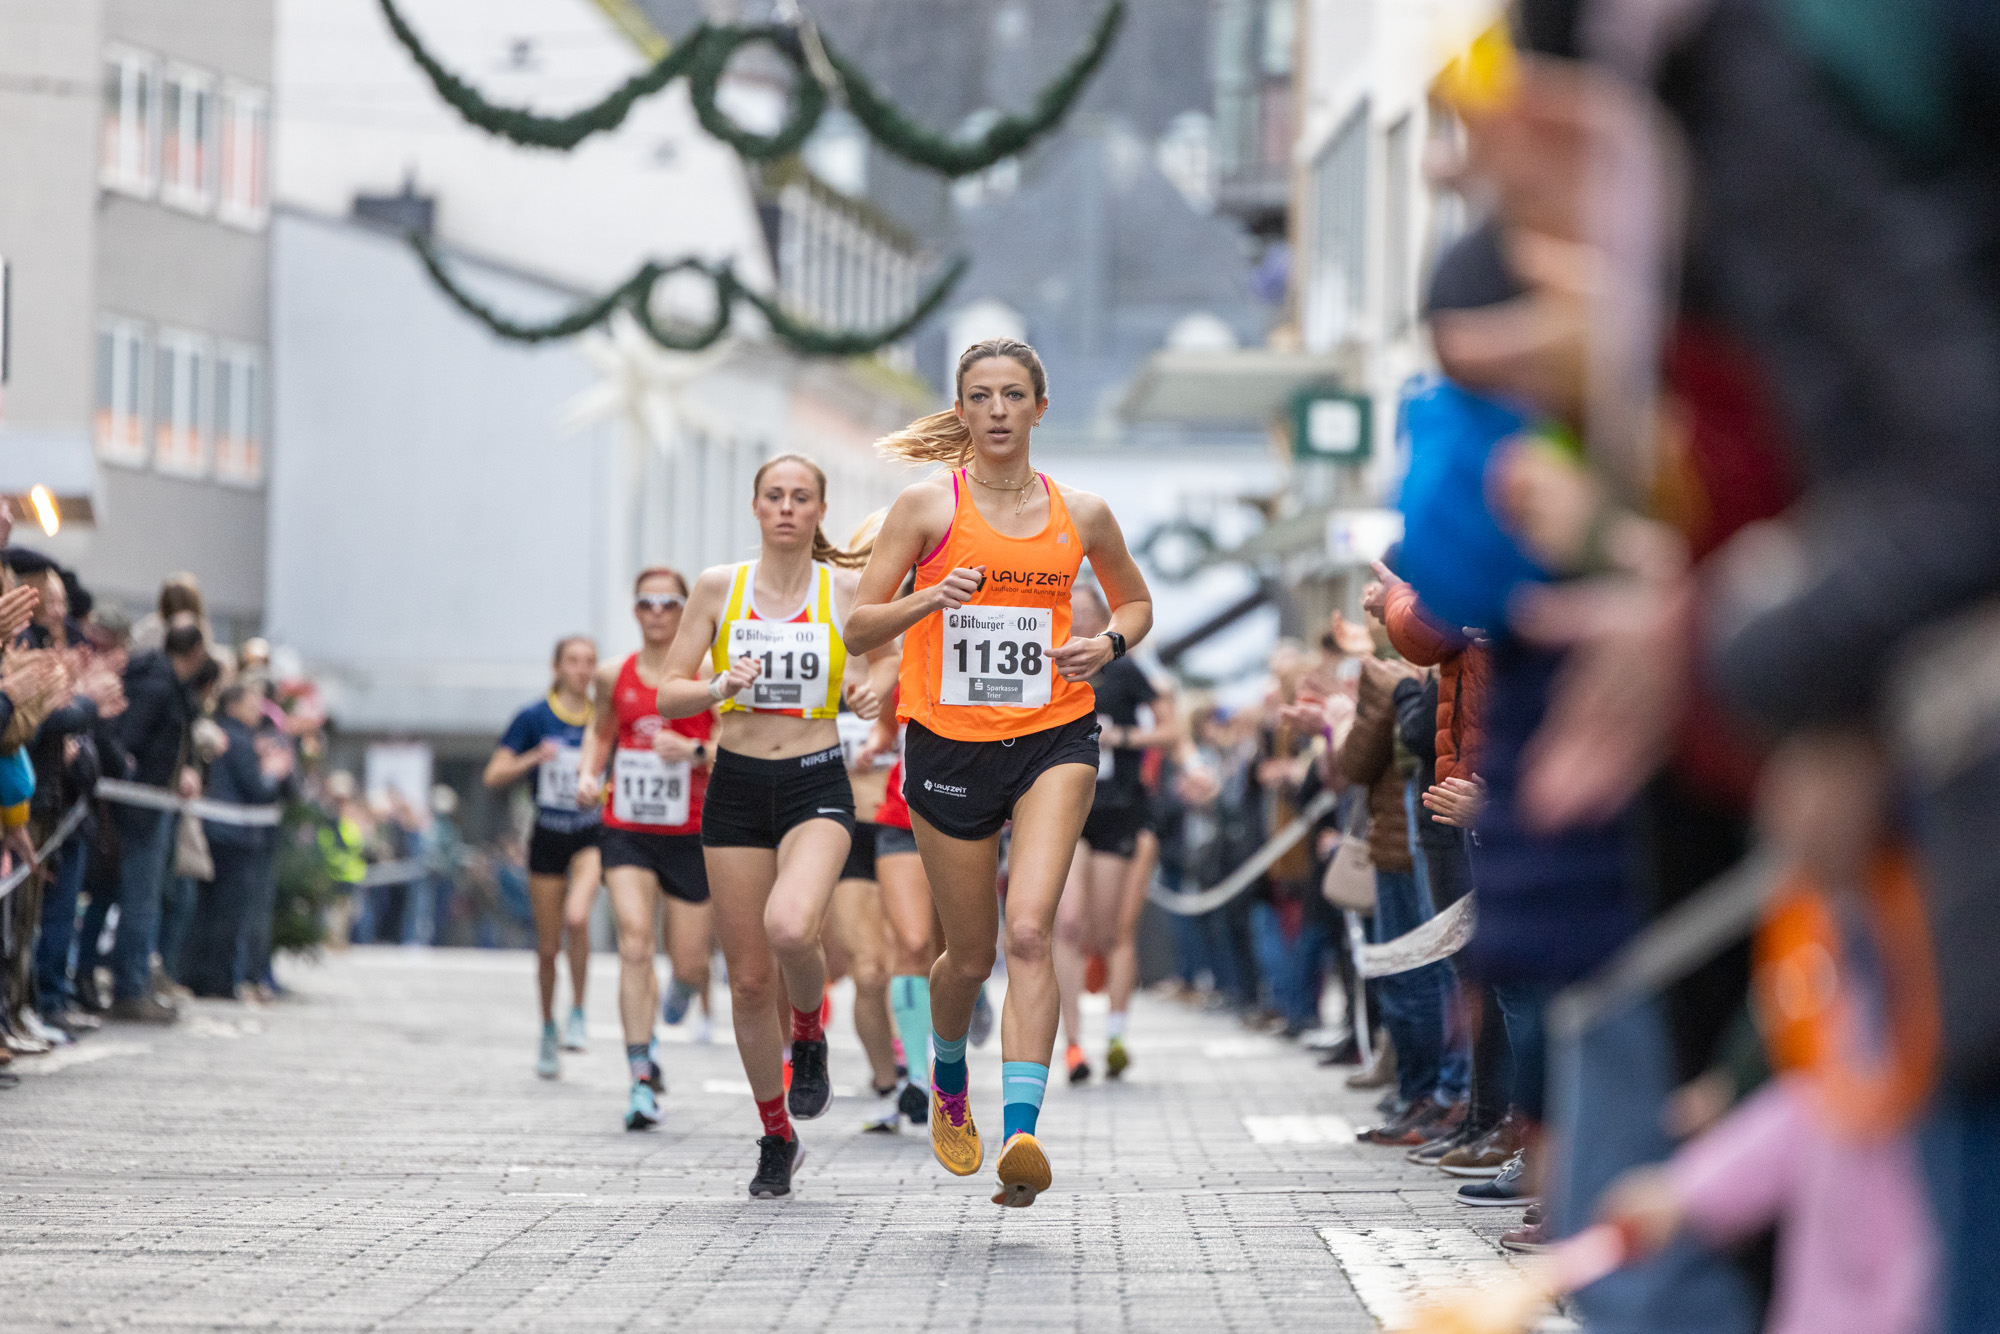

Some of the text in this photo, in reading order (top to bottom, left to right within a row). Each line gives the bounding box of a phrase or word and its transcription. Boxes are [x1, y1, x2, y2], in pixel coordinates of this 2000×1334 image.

[991, 585, 1019, 593] Lauflabor
[960, 614, 1037, 631] Bitburger 0.0
[953, 639, 1042, 676] 1138
[986, 684, 1018, 693] Sparkasse
[800, 751, 829, 768] NIKE
[829, 747, 842, 761] PR
[622, 776, 681, 799] 1128
